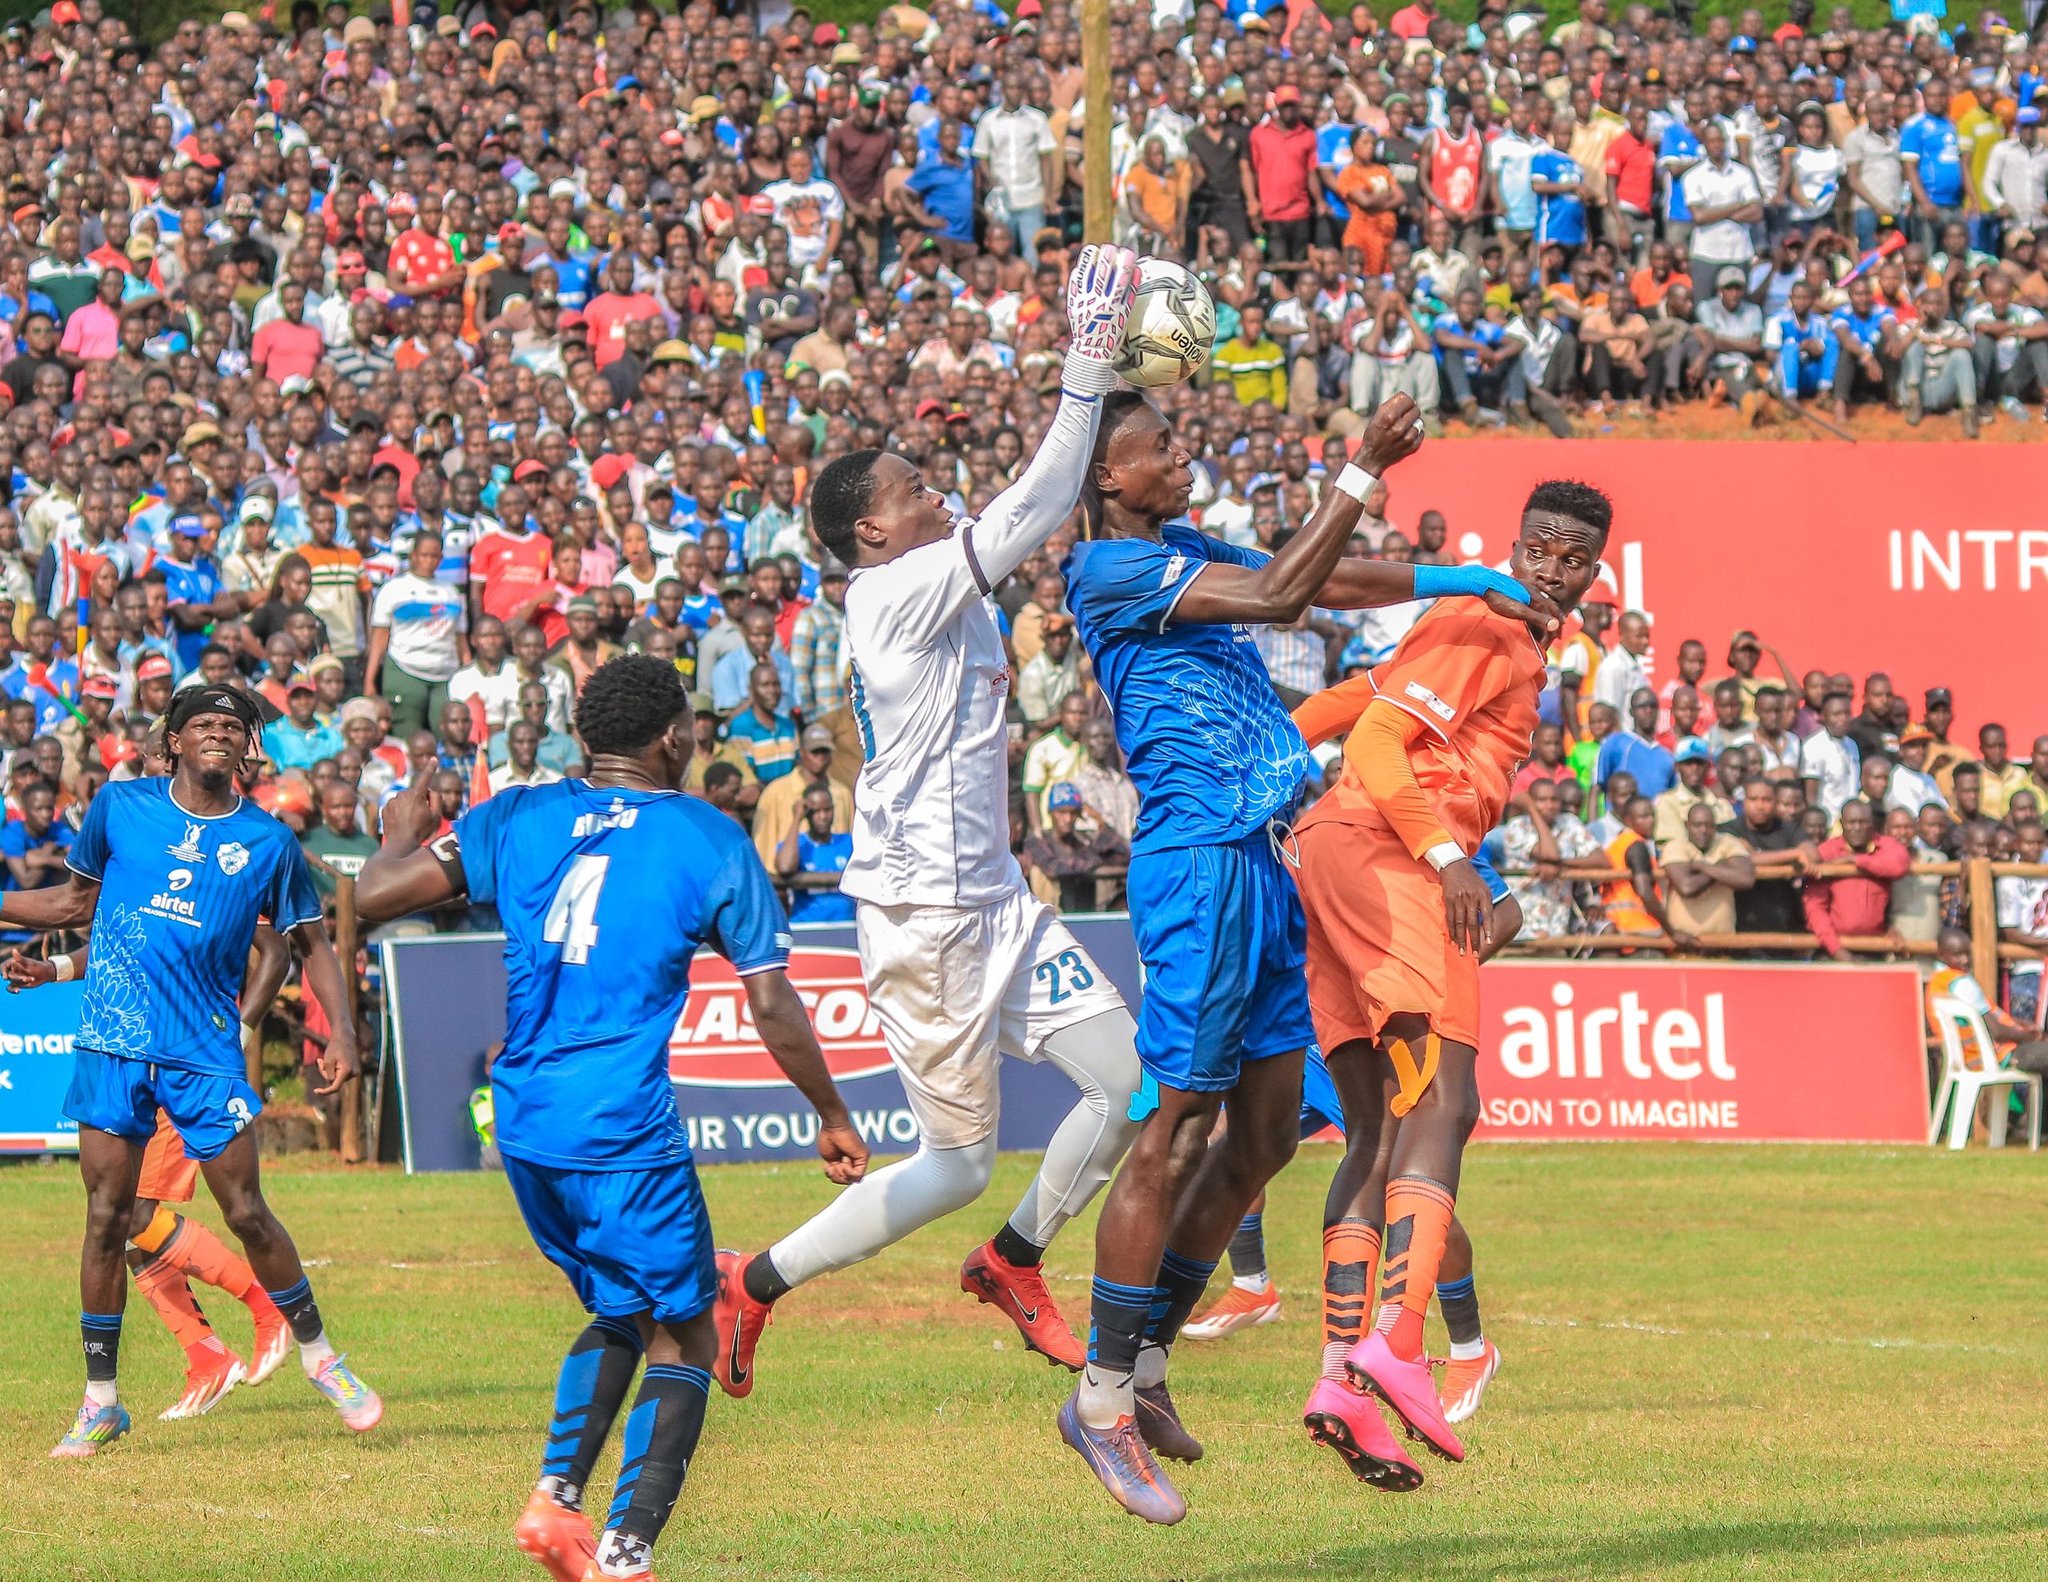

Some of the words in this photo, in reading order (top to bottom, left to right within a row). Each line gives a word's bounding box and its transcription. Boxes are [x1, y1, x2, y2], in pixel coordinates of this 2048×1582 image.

[150, 891, 195, 917] airtel
[543, 854, 611, 966] 4
[1036, 950, 1094, 1006] 23
[1500, 980, 1737, 1081] airtel
[1558, 1098, 1603, 1127] TO
[1609, 1098, 1740, 1128] IMAGINE
